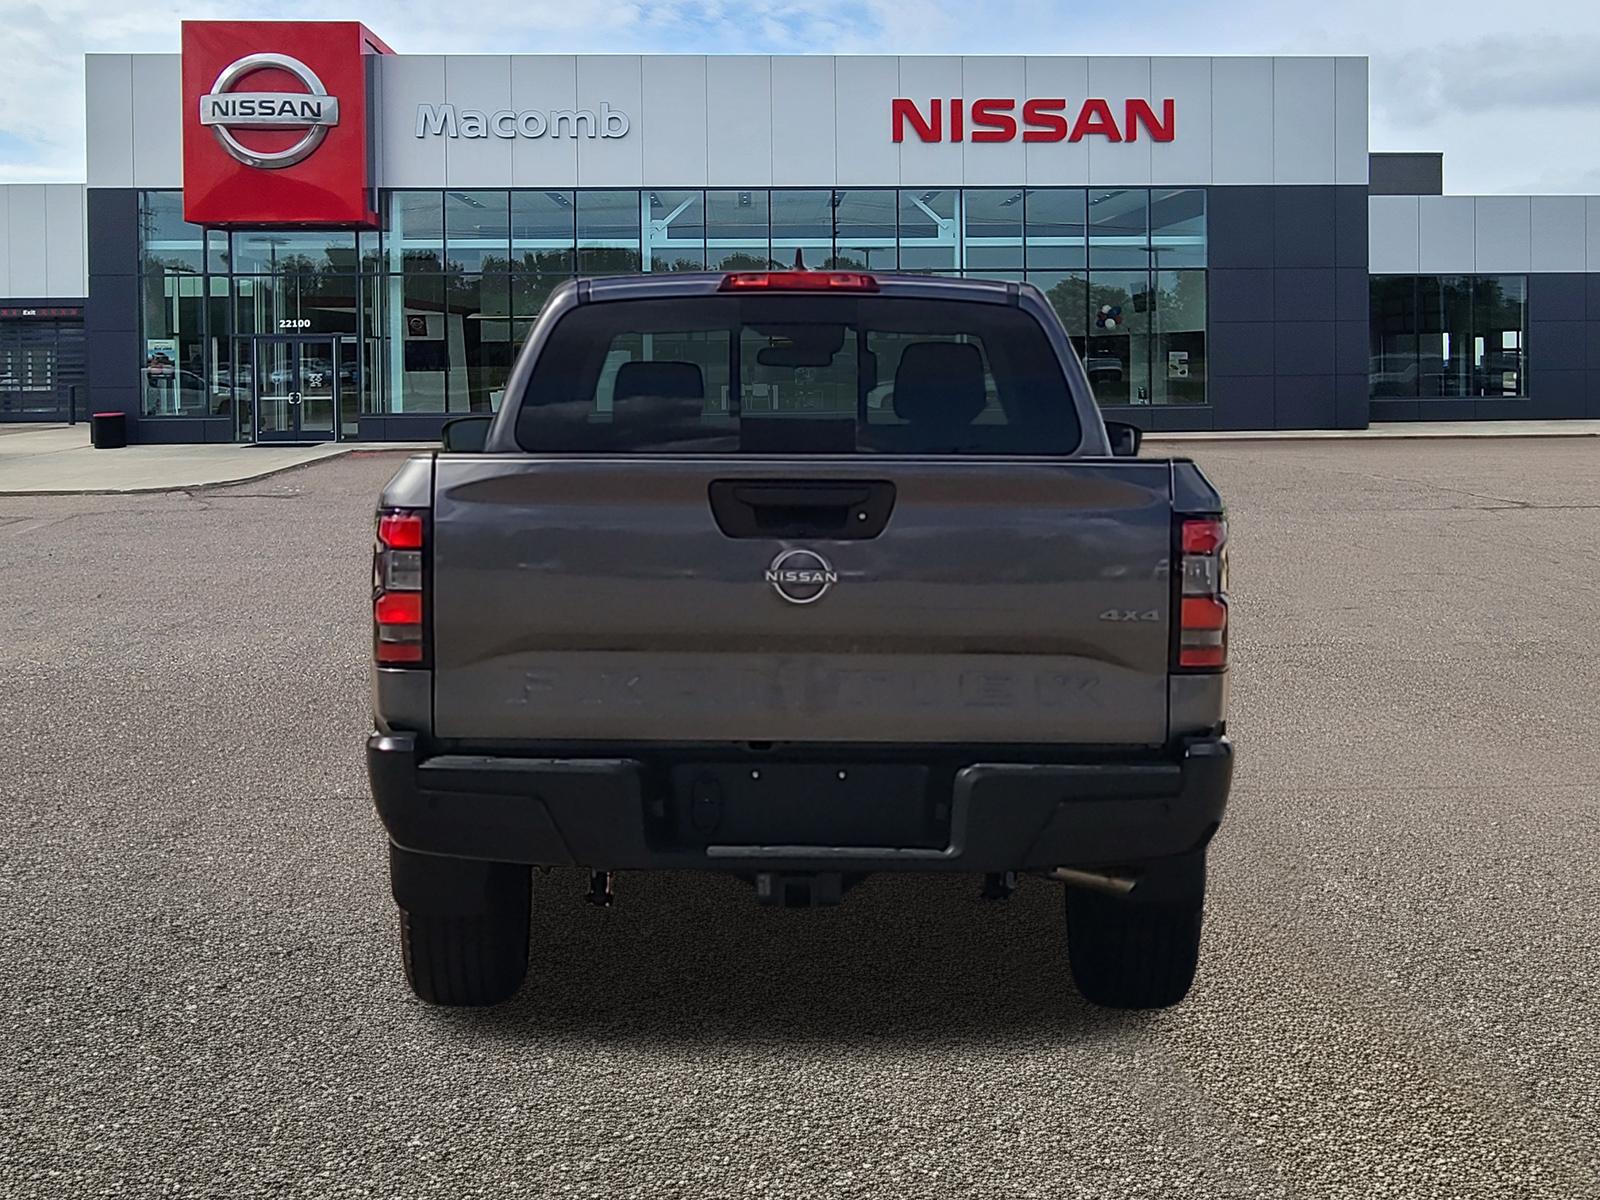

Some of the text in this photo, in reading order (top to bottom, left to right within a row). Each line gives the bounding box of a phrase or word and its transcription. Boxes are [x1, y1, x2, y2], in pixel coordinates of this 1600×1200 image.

[211, 99, 322, 118] NISSAN
[414, 102, 630, 139] Macomb
[892, 98, 1175, 143] NISSAN
[279, 319, 311, 328] 22100
[765, 571, 837, 582] NISSAN
